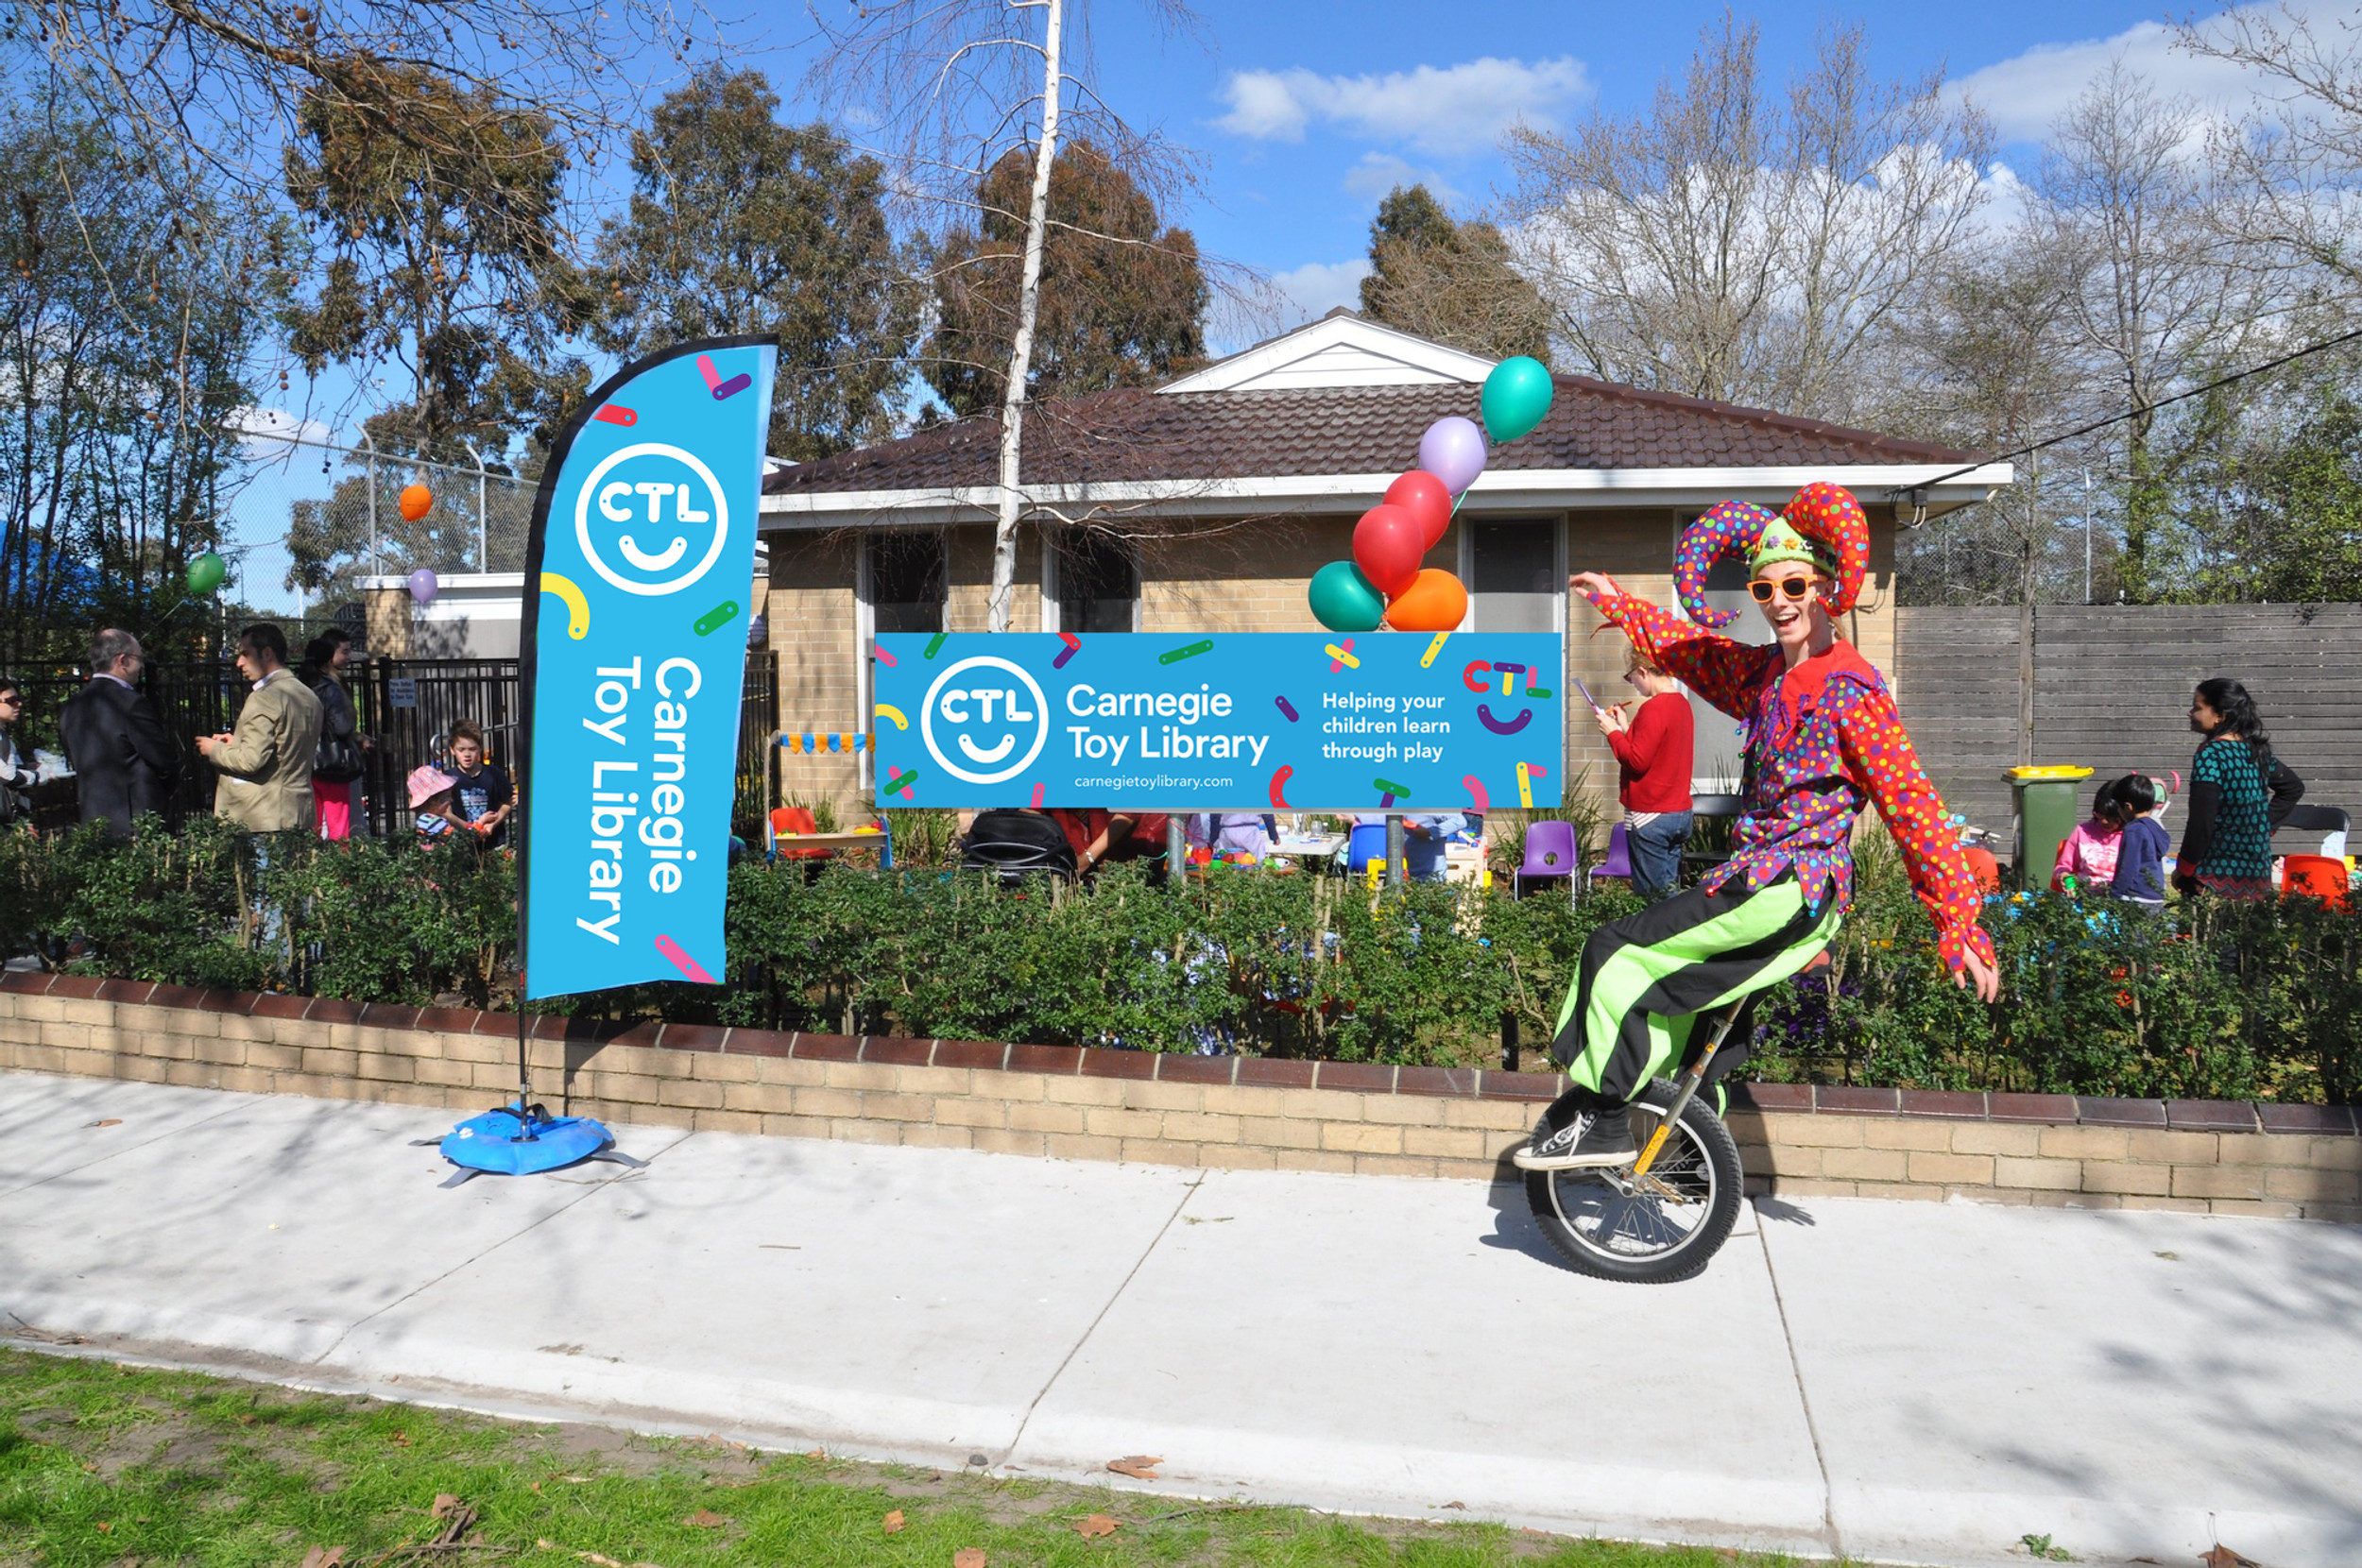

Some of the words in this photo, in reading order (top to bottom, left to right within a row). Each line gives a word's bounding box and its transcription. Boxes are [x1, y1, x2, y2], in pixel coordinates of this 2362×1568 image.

[598, 482, 710, 523] CTL
[1463, 659, 1552, 699] CTL
[583, 656, 642, 745] Toy
[940, 690, 1034, 724] CTL
[1067, 683, 1232, 725] Carnegie
[1323, 691, 1395, 713] Helping
[1402, 697, 1446, 713] your
[1323, 716, 1396, 733] children
[1404, 716, 1450, 733] learn
[1067, 726, 1130, 766] Toy
[1139, 724, 1270, 766] Library
[1322, 741, 1397, 763] through
[1404, 741, 1444, 763] play
[638, 656, 702, 894] Carnegie
[1074, 775, 1233, 791] carnegietoylibrary.com
[576, 761, 639, 945] Library
